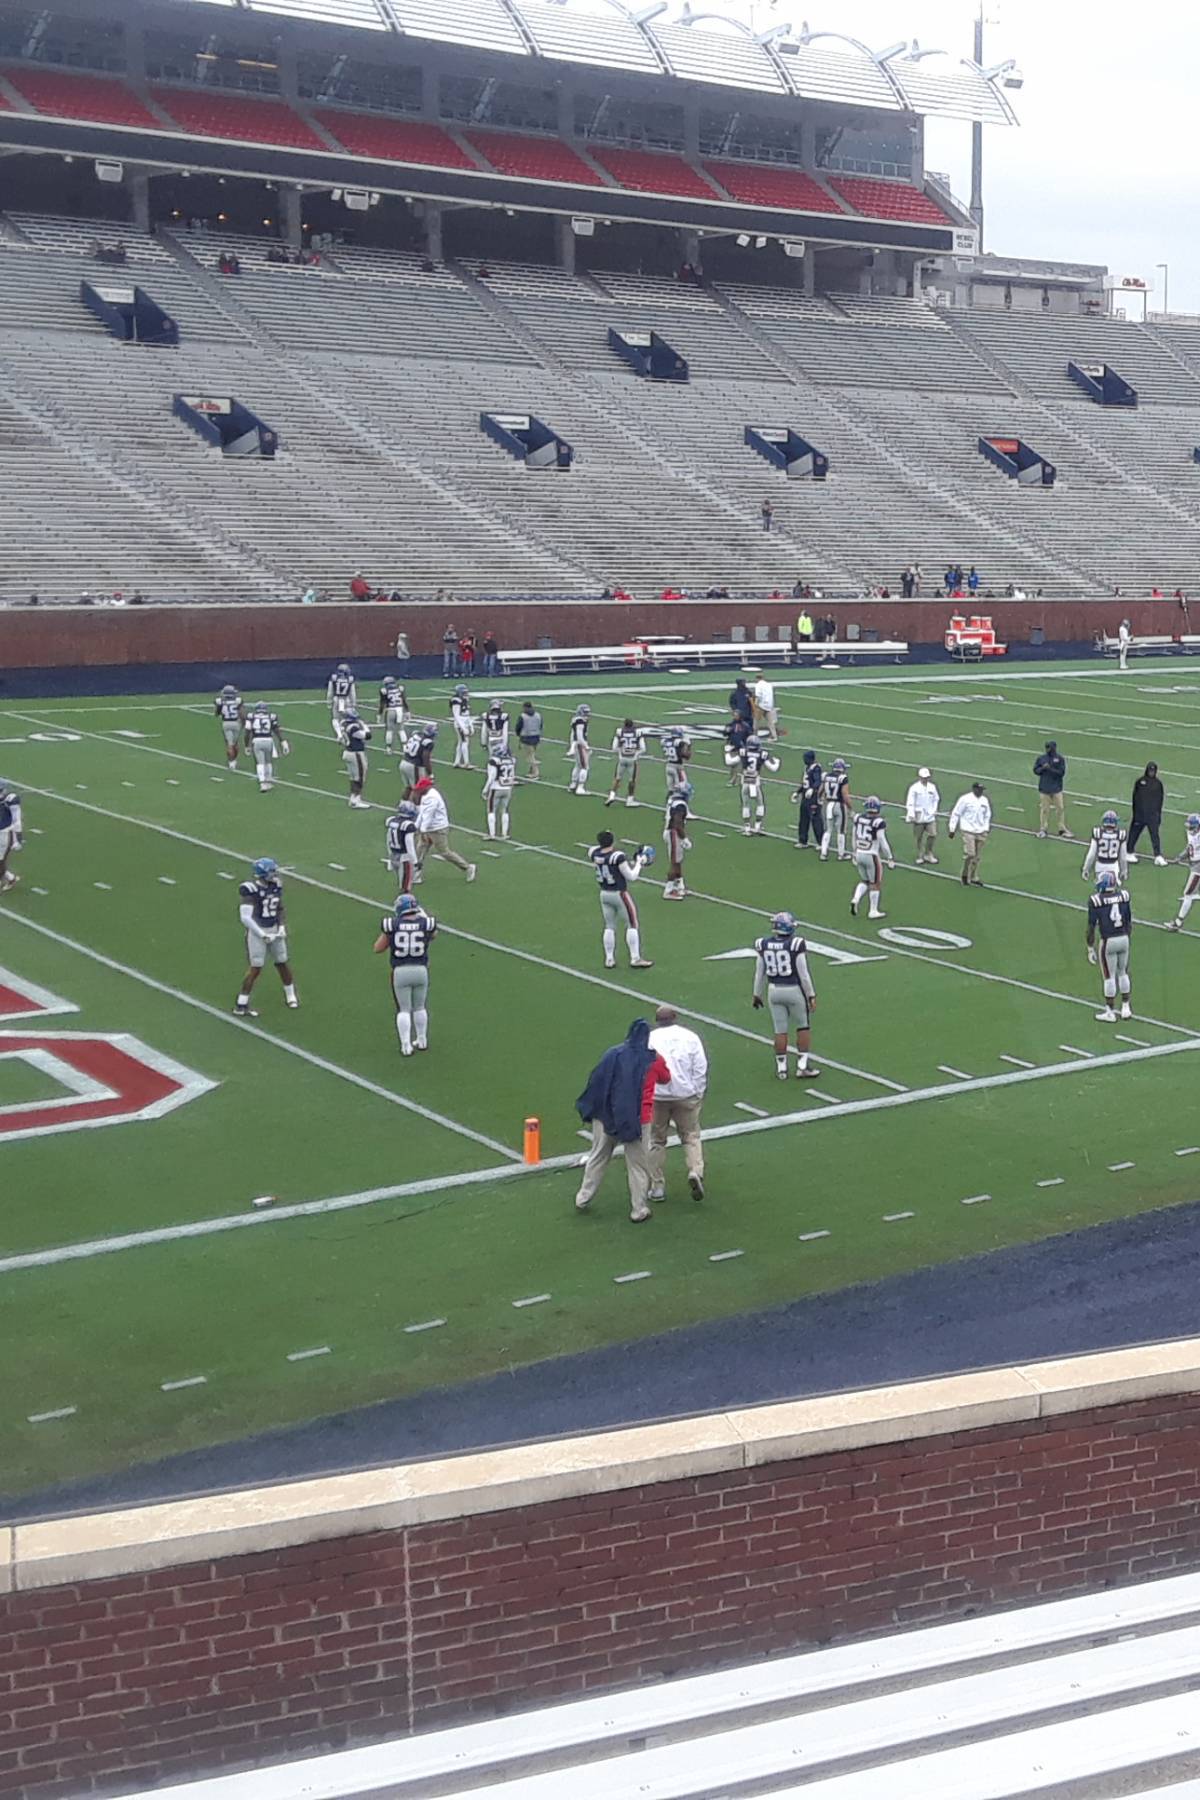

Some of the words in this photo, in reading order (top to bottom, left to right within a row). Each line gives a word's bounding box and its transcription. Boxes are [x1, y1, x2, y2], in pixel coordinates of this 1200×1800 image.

[334, 682, 351, 696] 17
[253, 718, 272, 735] 43
[1097, 838, 1120, 859] 28
[1109, 902, 1124, 928] 4
[394, 930, 426, 958] 96
[763, 949, 793, 977] 88
